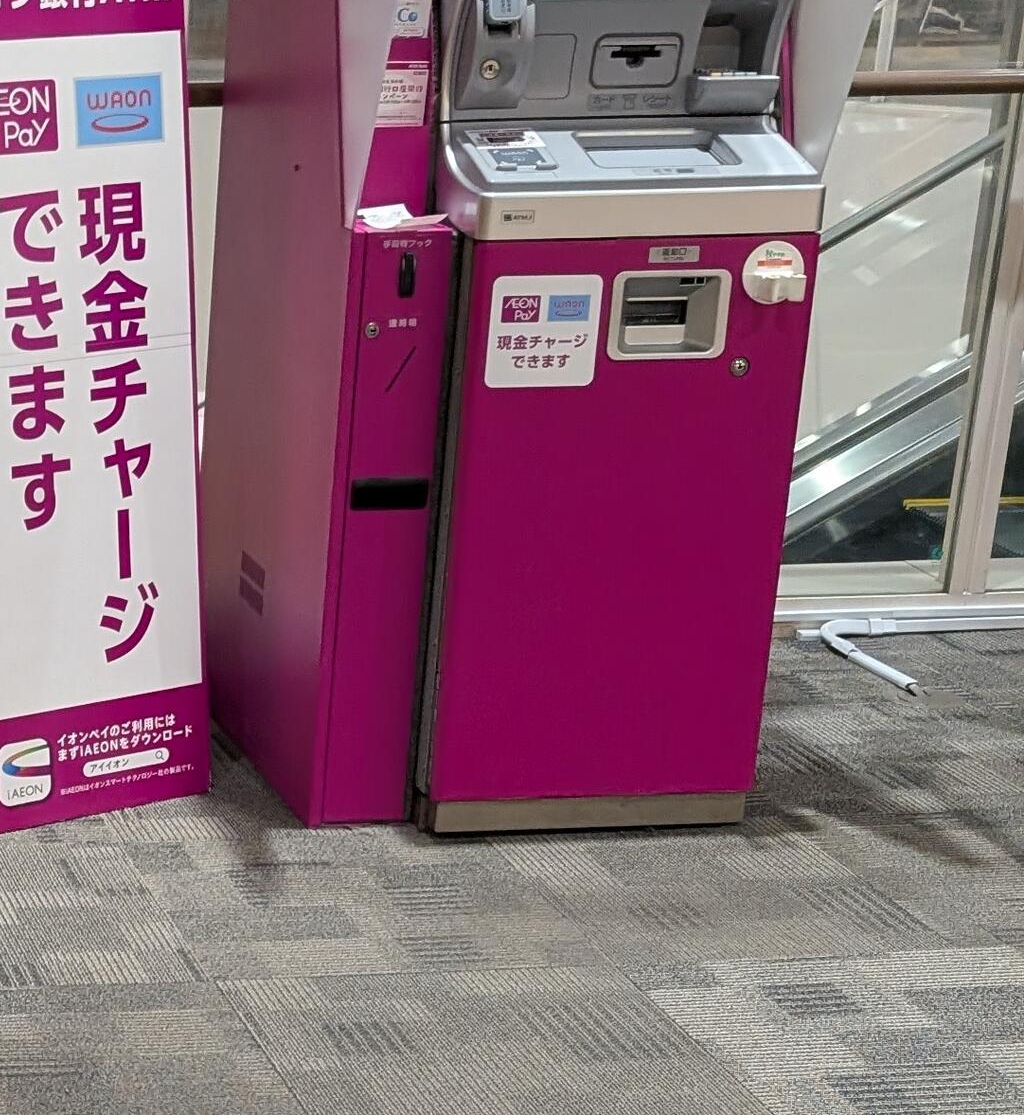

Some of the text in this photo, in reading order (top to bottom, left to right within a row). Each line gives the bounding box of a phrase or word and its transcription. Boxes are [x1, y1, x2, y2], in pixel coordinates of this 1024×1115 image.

[496, 333, 589, 351] 現金チャージ
[511, 354, 570, 369] できます
[77, 181, 160, 664] 現金チャージ
[57, 713, 176, 748] イオンペイのご利用には
[90, 758, 130, 773] アイイオン
